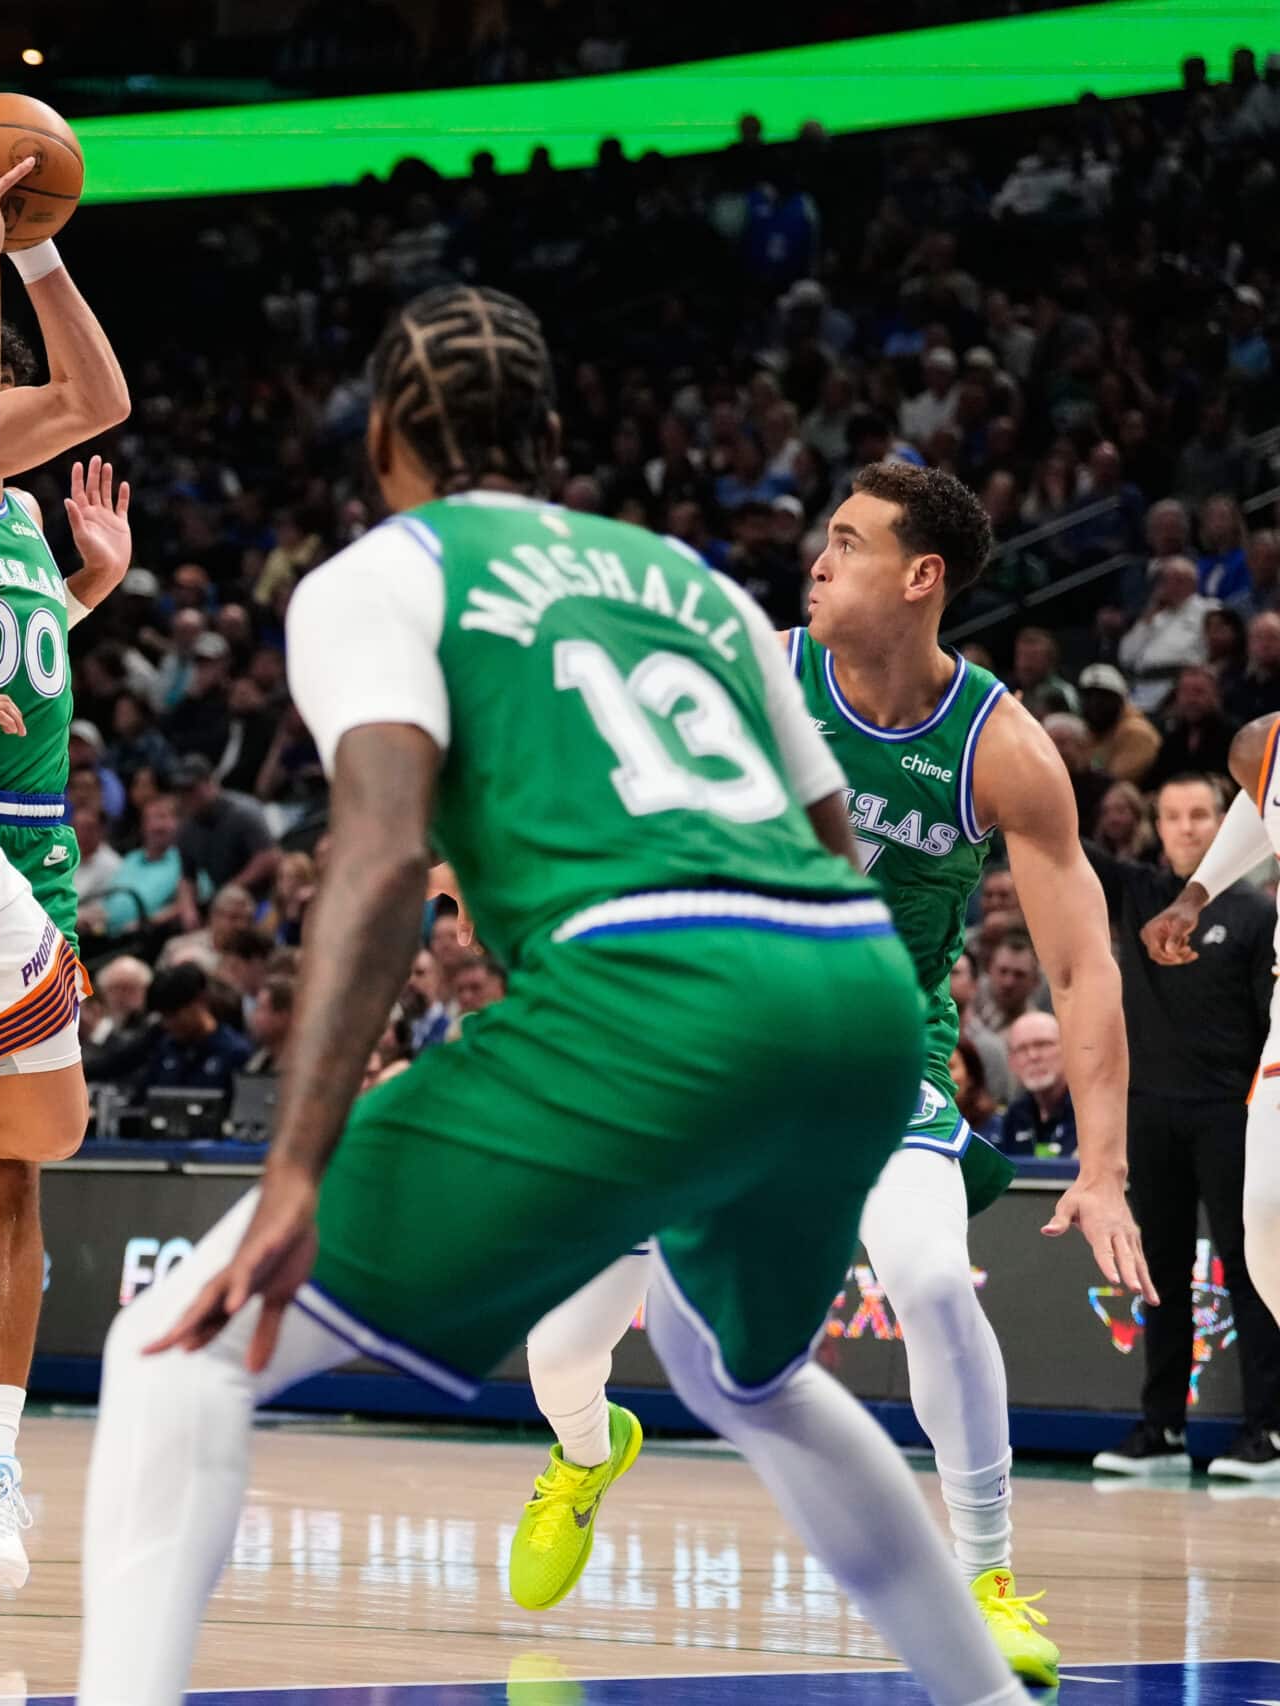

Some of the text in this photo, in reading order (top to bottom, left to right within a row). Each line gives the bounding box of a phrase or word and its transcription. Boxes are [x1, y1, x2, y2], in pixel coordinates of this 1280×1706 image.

[459, 544, 740, 662] MARSHALL
[553, 639, 788, 824] 13
[901, 754, 953, 783] chime
